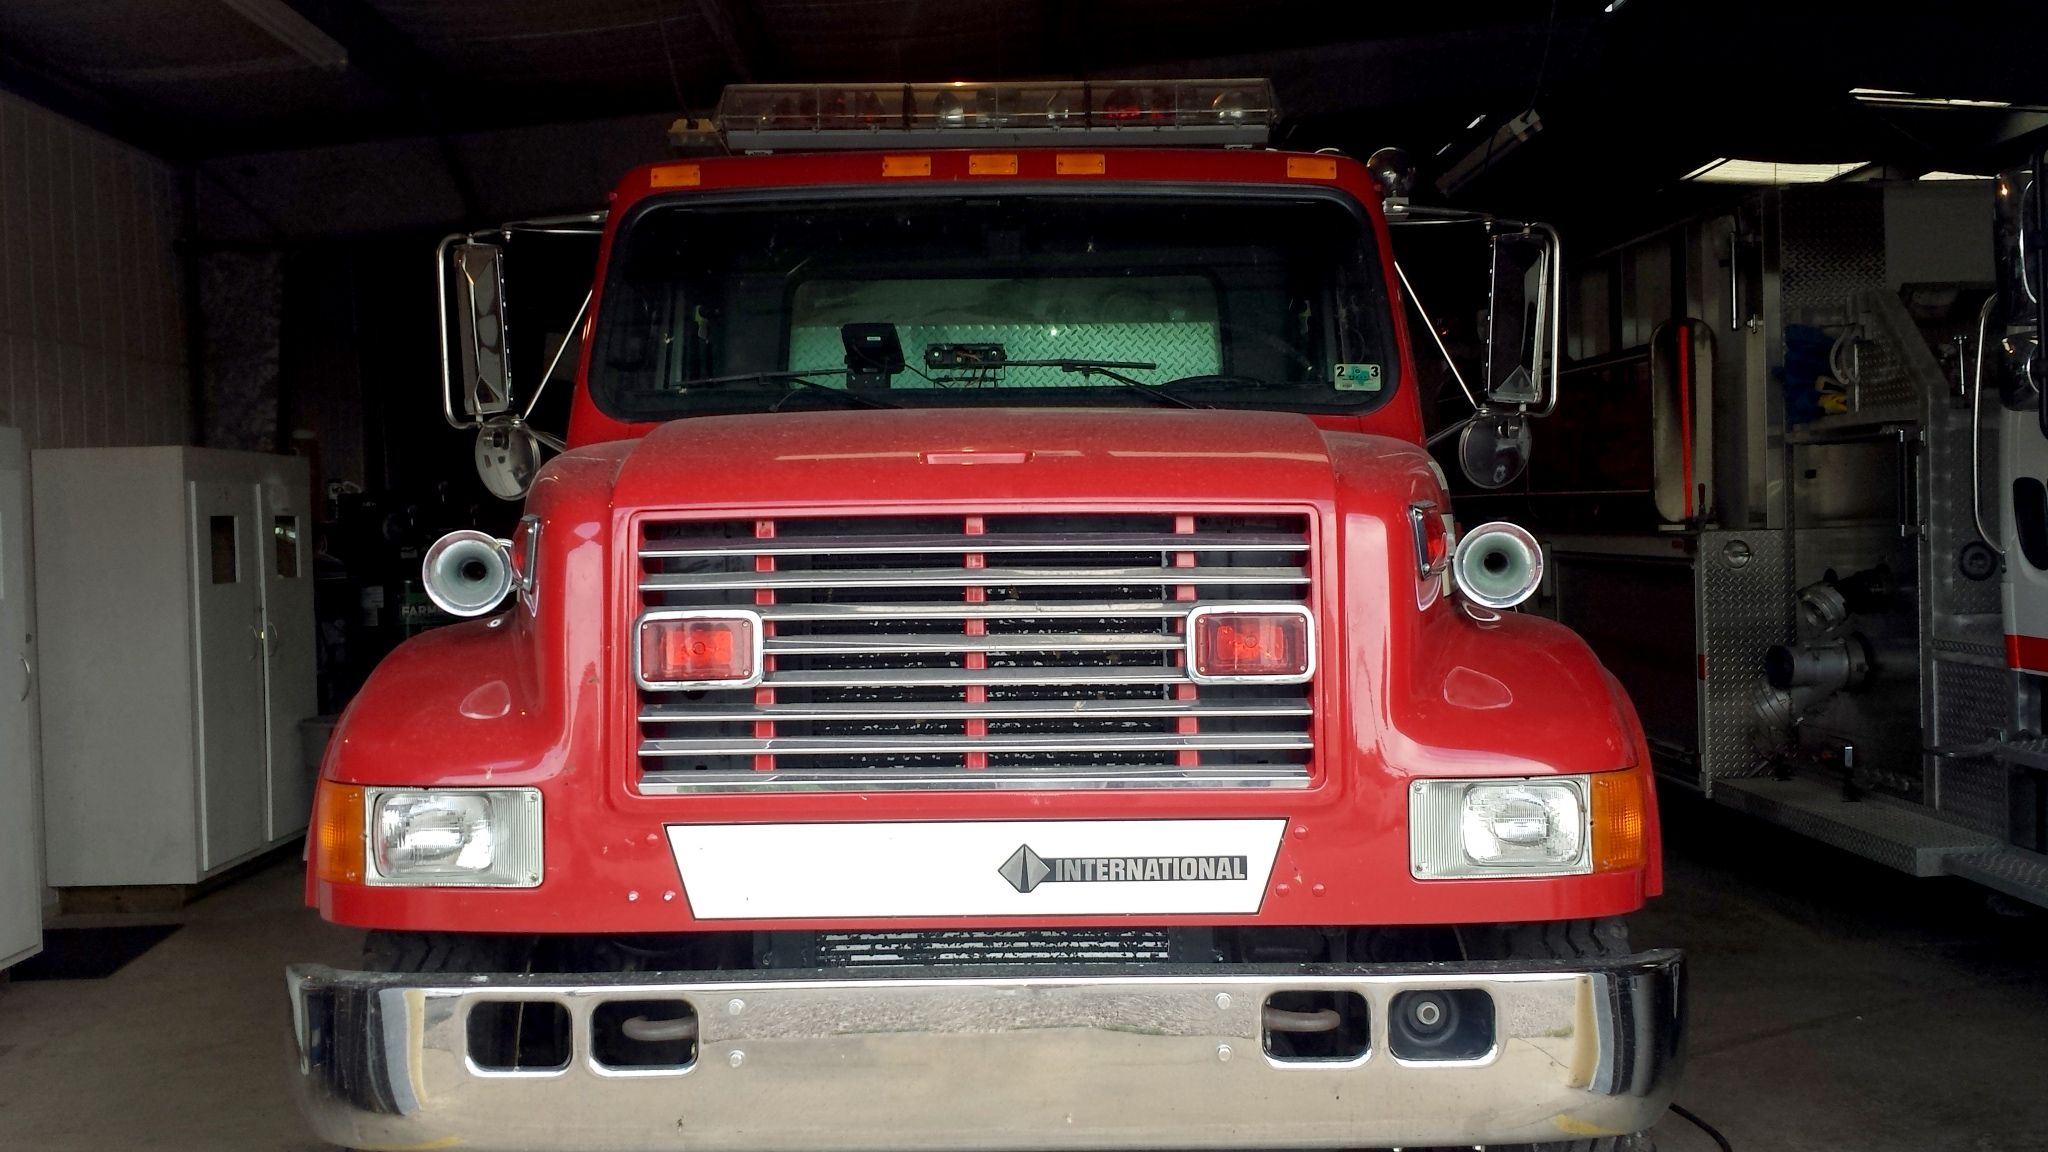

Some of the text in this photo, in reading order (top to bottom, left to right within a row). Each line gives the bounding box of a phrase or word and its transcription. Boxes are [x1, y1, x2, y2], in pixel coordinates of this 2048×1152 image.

[1336, 366, 1379, 377] 2 3
[1055, 857, 1246, 881] INTERNATIONAL
